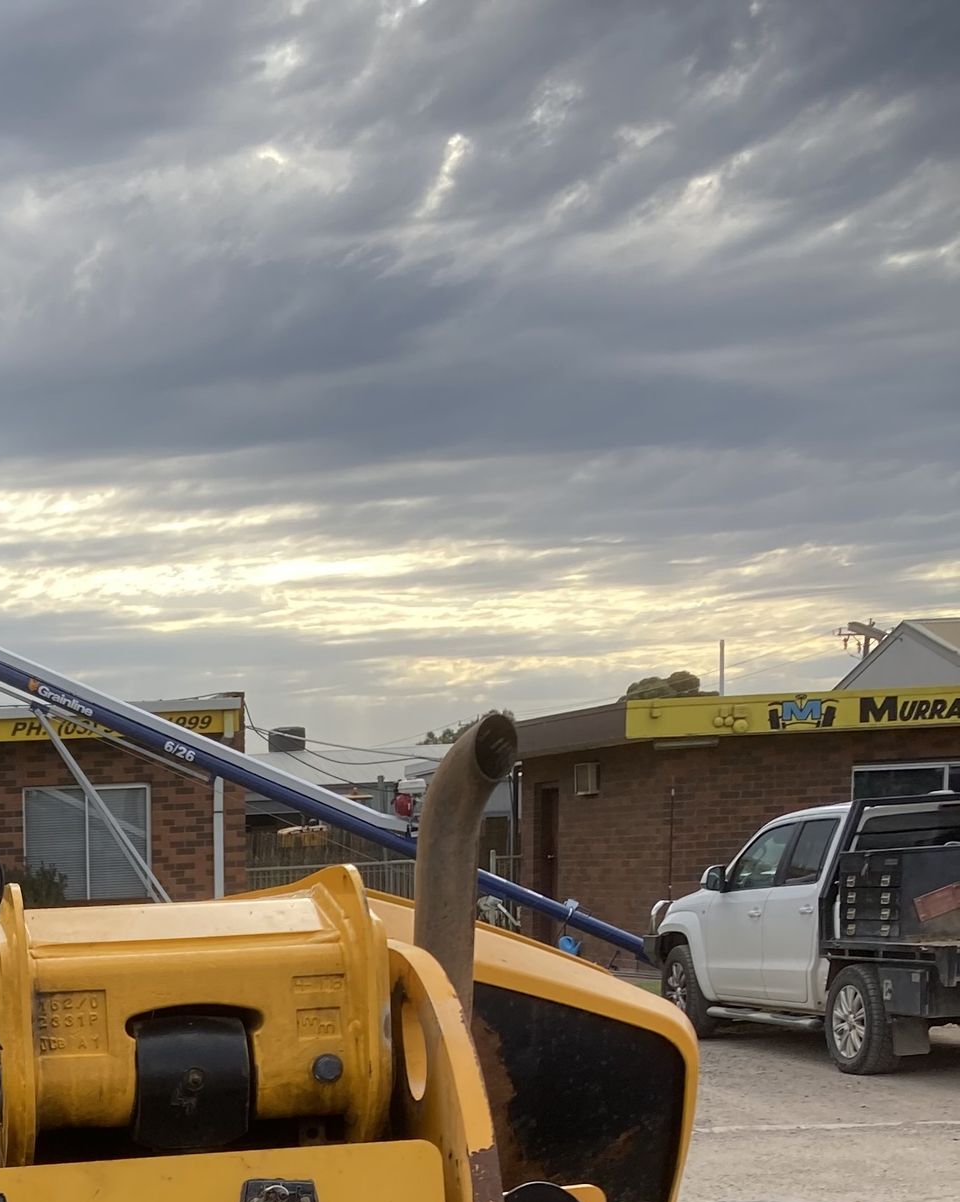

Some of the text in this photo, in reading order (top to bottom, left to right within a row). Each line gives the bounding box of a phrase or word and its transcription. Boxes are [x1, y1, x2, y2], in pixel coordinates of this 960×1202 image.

[38, 685, 94, 717] Grainline
[11, 722, 47, 736] PH.
[164, 741, 196, 762] 6/26
